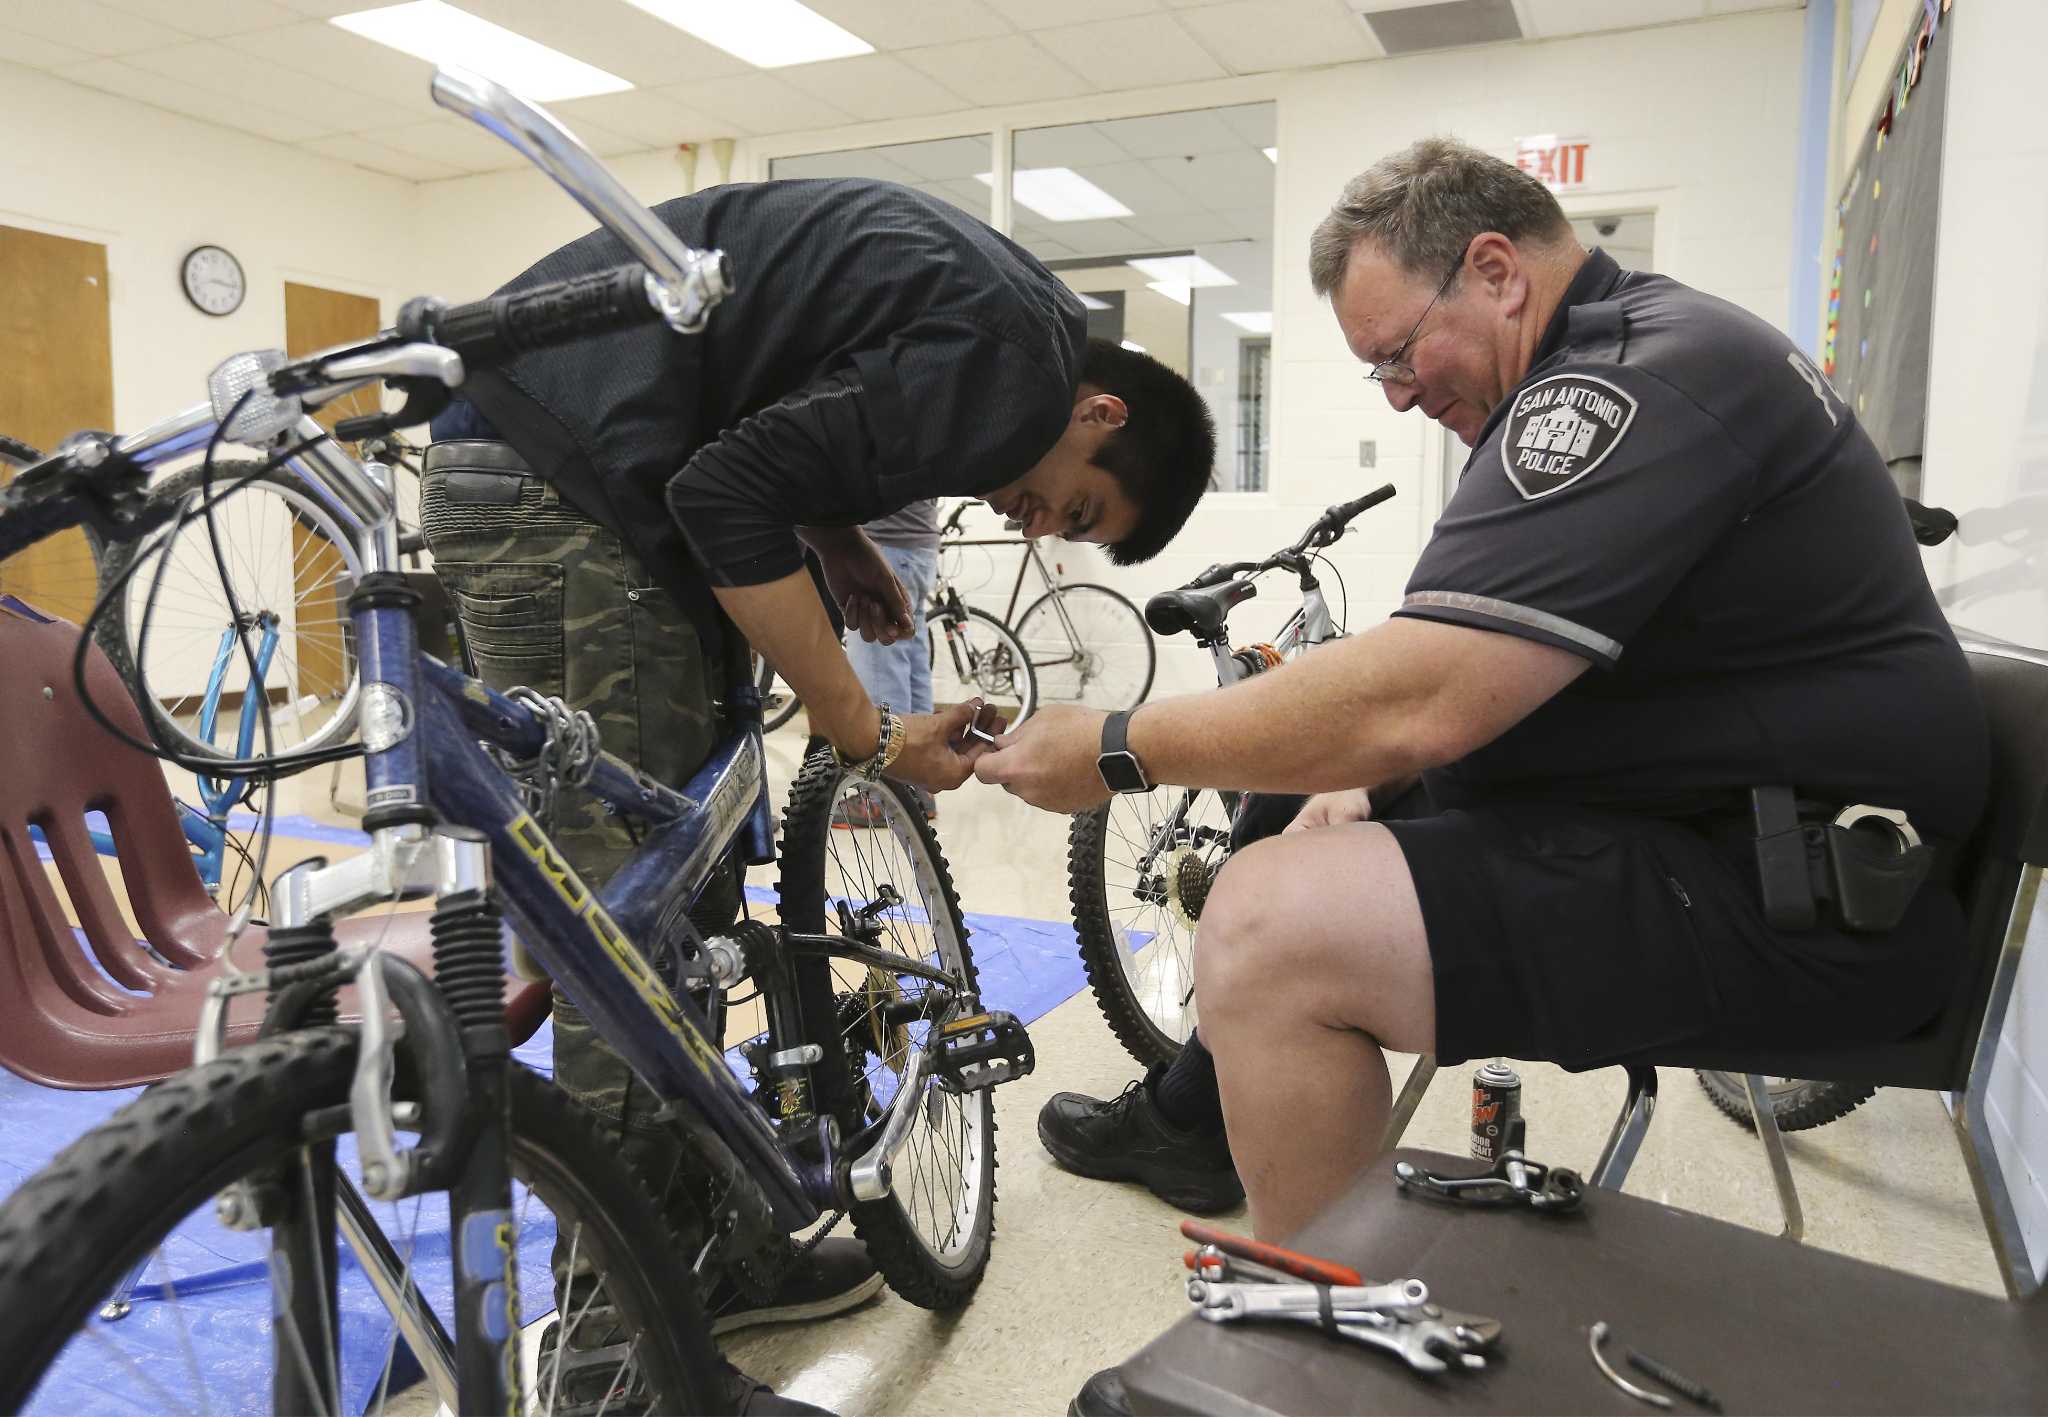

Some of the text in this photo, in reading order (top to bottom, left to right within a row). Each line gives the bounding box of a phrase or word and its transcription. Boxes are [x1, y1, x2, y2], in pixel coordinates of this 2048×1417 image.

[1516, 386, 1622, 429] SAN ANTONIO
[1516, 449, 1577, 475] POLICE
